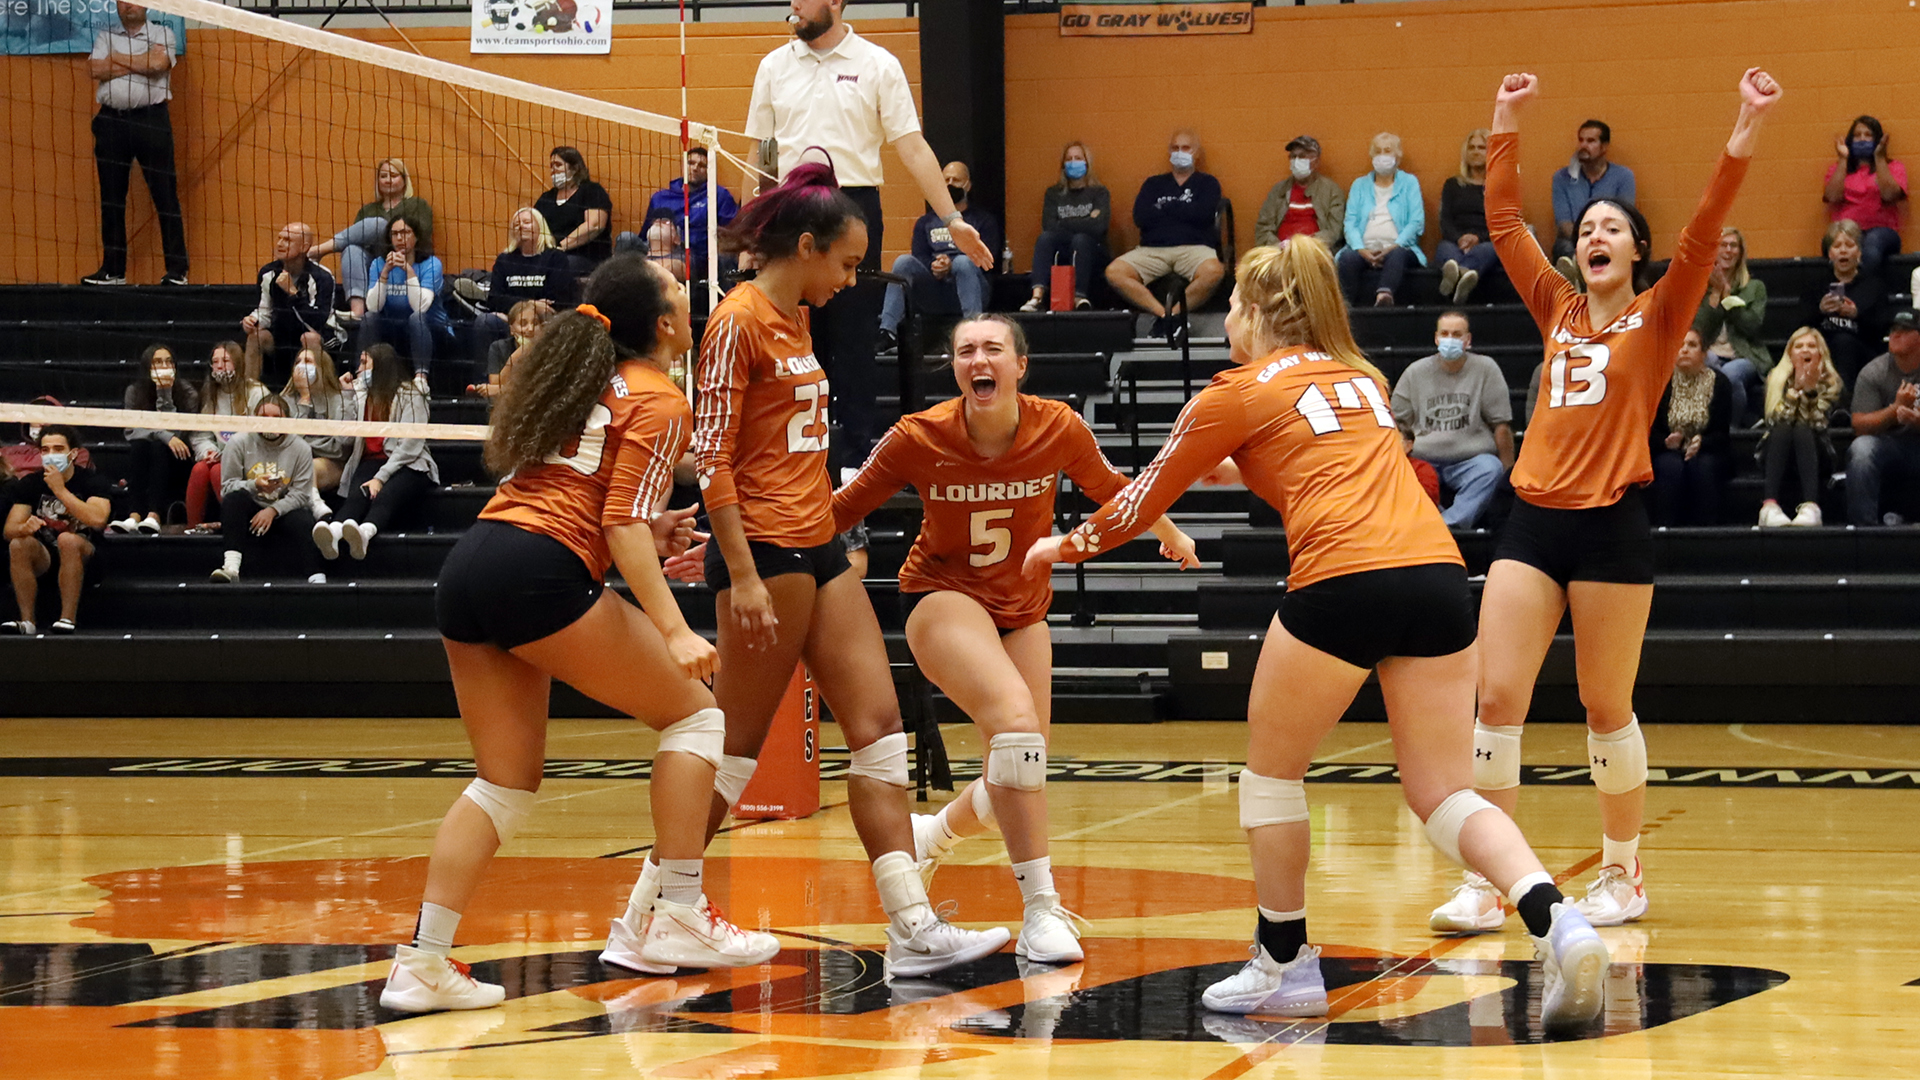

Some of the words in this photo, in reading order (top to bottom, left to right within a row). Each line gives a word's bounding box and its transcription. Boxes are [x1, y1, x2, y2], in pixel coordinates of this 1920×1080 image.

[1061, 15, 1090, 28] GO
[1096, 14, 1150, 27] GRAY
[1157, 10, 1250, 32] WLVES!
[476, 37, 606, 47] www.teamsportsohio.com
[1256, 354, 1301, 383] GRAY
[1549, 343, 1611, 408] 13
[787, 379, 829, 453] 23
[1294, 376, 1396, 436] 14
[1425, 414, 1470, 431] NATION
[929, 474, 1055, 502] LOURDES
[969, 508, 1014, 567] 5
[740, 804, 756, 812] (800)
